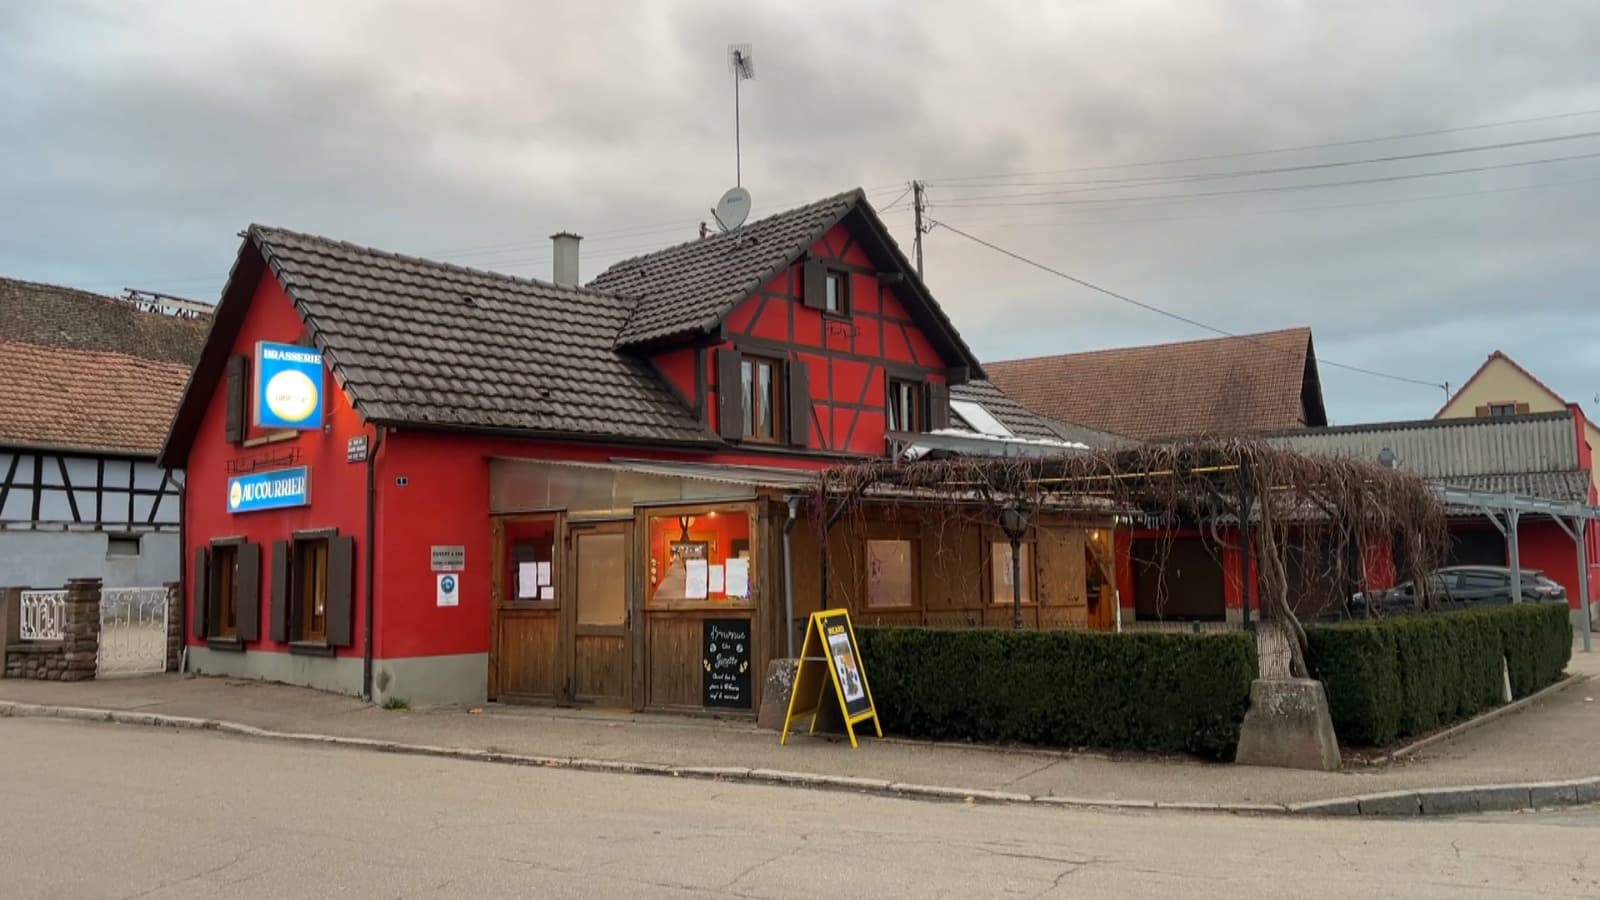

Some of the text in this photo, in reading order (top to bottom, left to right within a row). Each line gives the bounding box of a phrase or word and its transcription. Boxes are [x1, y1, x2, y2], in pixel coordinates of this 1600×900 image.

[263, 348, 322, 365] BRASSERIE
[241, 476, 305, 502] AU COURRIER
